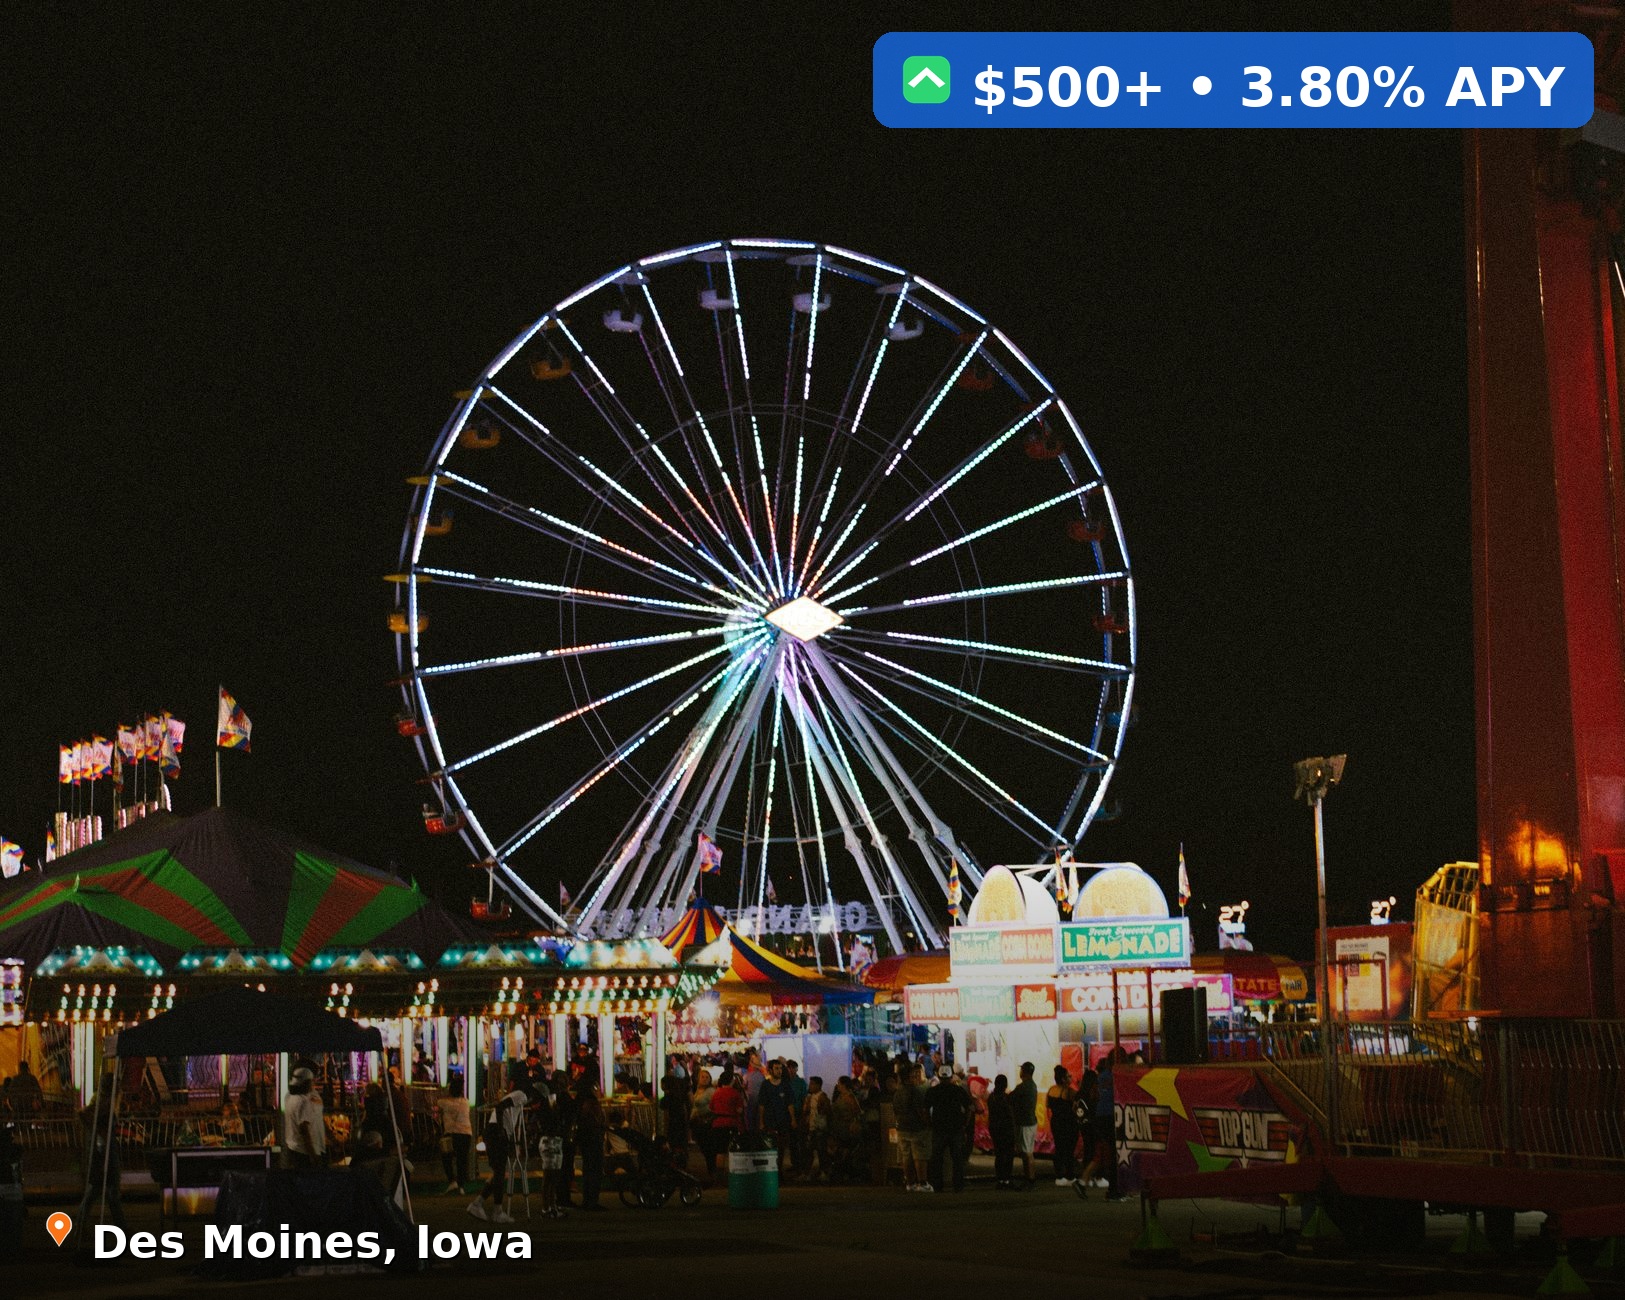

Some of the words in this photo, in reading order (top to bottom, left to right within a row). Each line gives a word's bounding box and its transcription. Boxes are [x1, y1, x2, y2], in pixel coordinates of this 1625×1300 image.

[1063, 927, 1181, 960] LEMONADE
[1235, 977, 1277, 991] TATE
[1124, 1105, 1153, 1142] GUN
[1216, 1109, 1242, 1148] TOP
[1241, 1110, 1269, 1151] GUN
